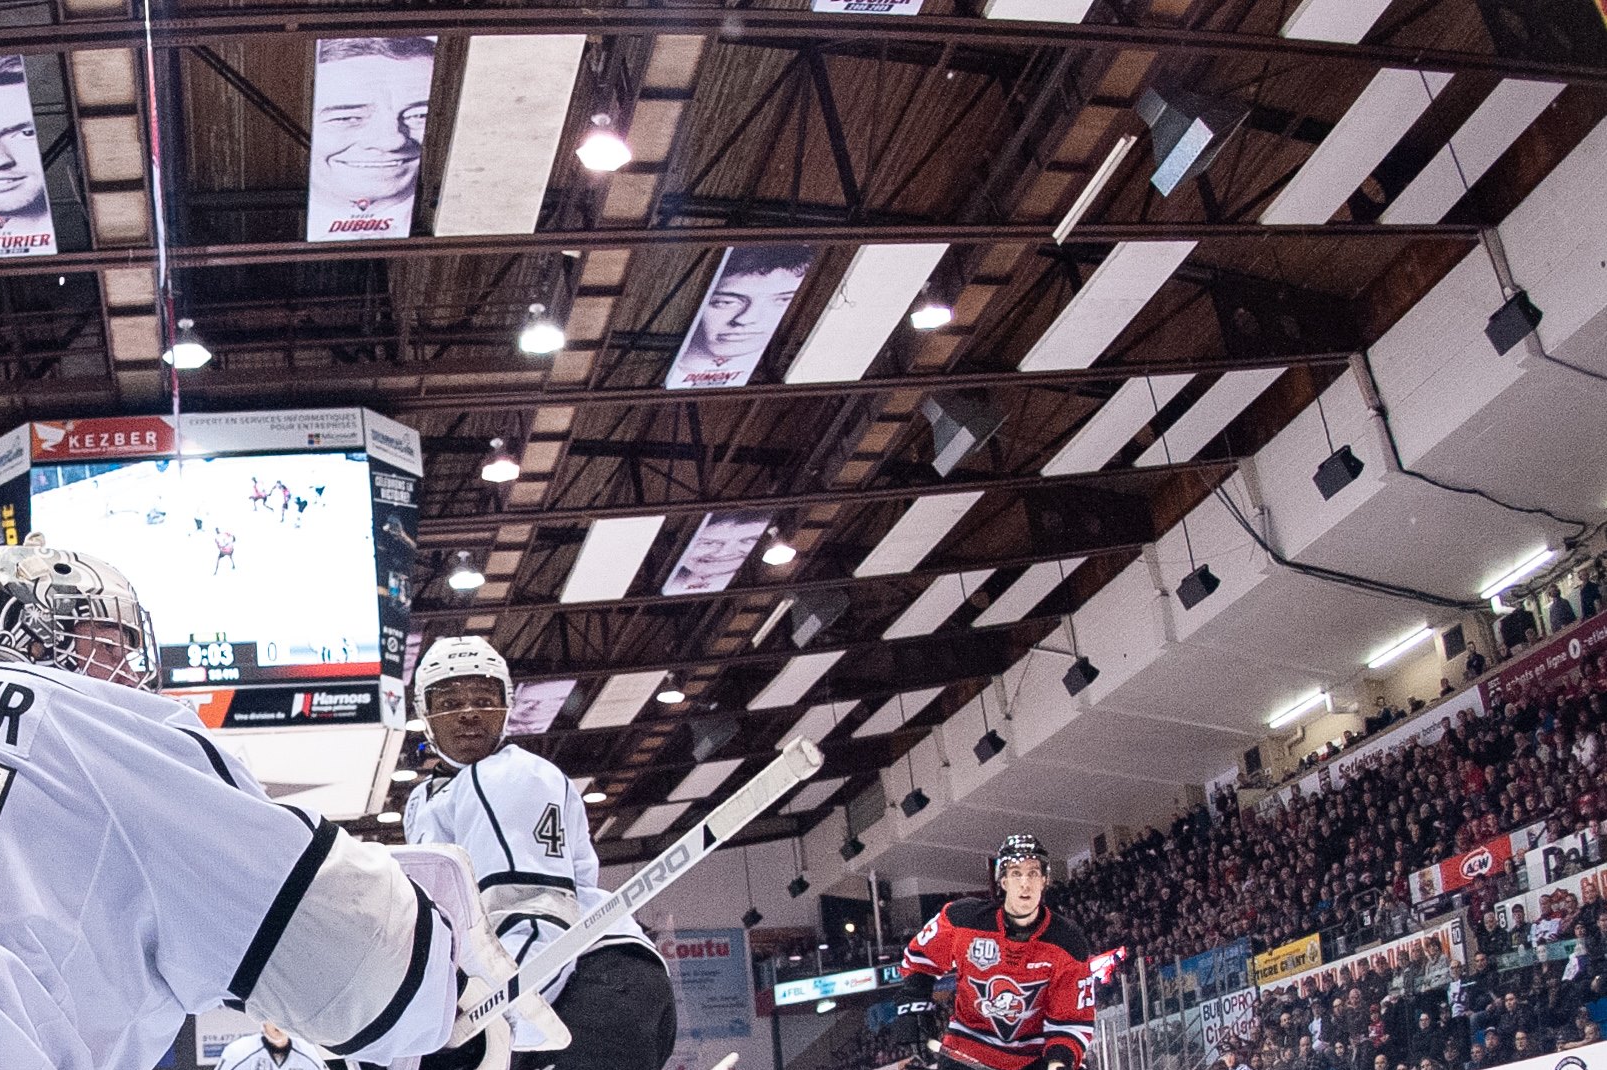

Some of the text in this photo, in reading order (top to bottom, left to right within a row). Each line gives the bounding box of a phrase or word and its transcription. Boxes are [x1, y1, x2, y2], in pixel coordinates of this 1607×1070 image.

[328, 217, 394, 233] DUBOIS
[68, 431, 158, 449] KEZBER
[186, 642, 235, 667] 9:03
[447, 650, 479, 660] CCM
[313, 692, 372, 706] Harnois
[533, 802, 566, 859] 4
[621, 843, 692, 910] PRO
[582, 896, 621, 930] CUSTOM
[974, 942, 994, 959] 50
[467, 988, 506, 1024] RIOR
